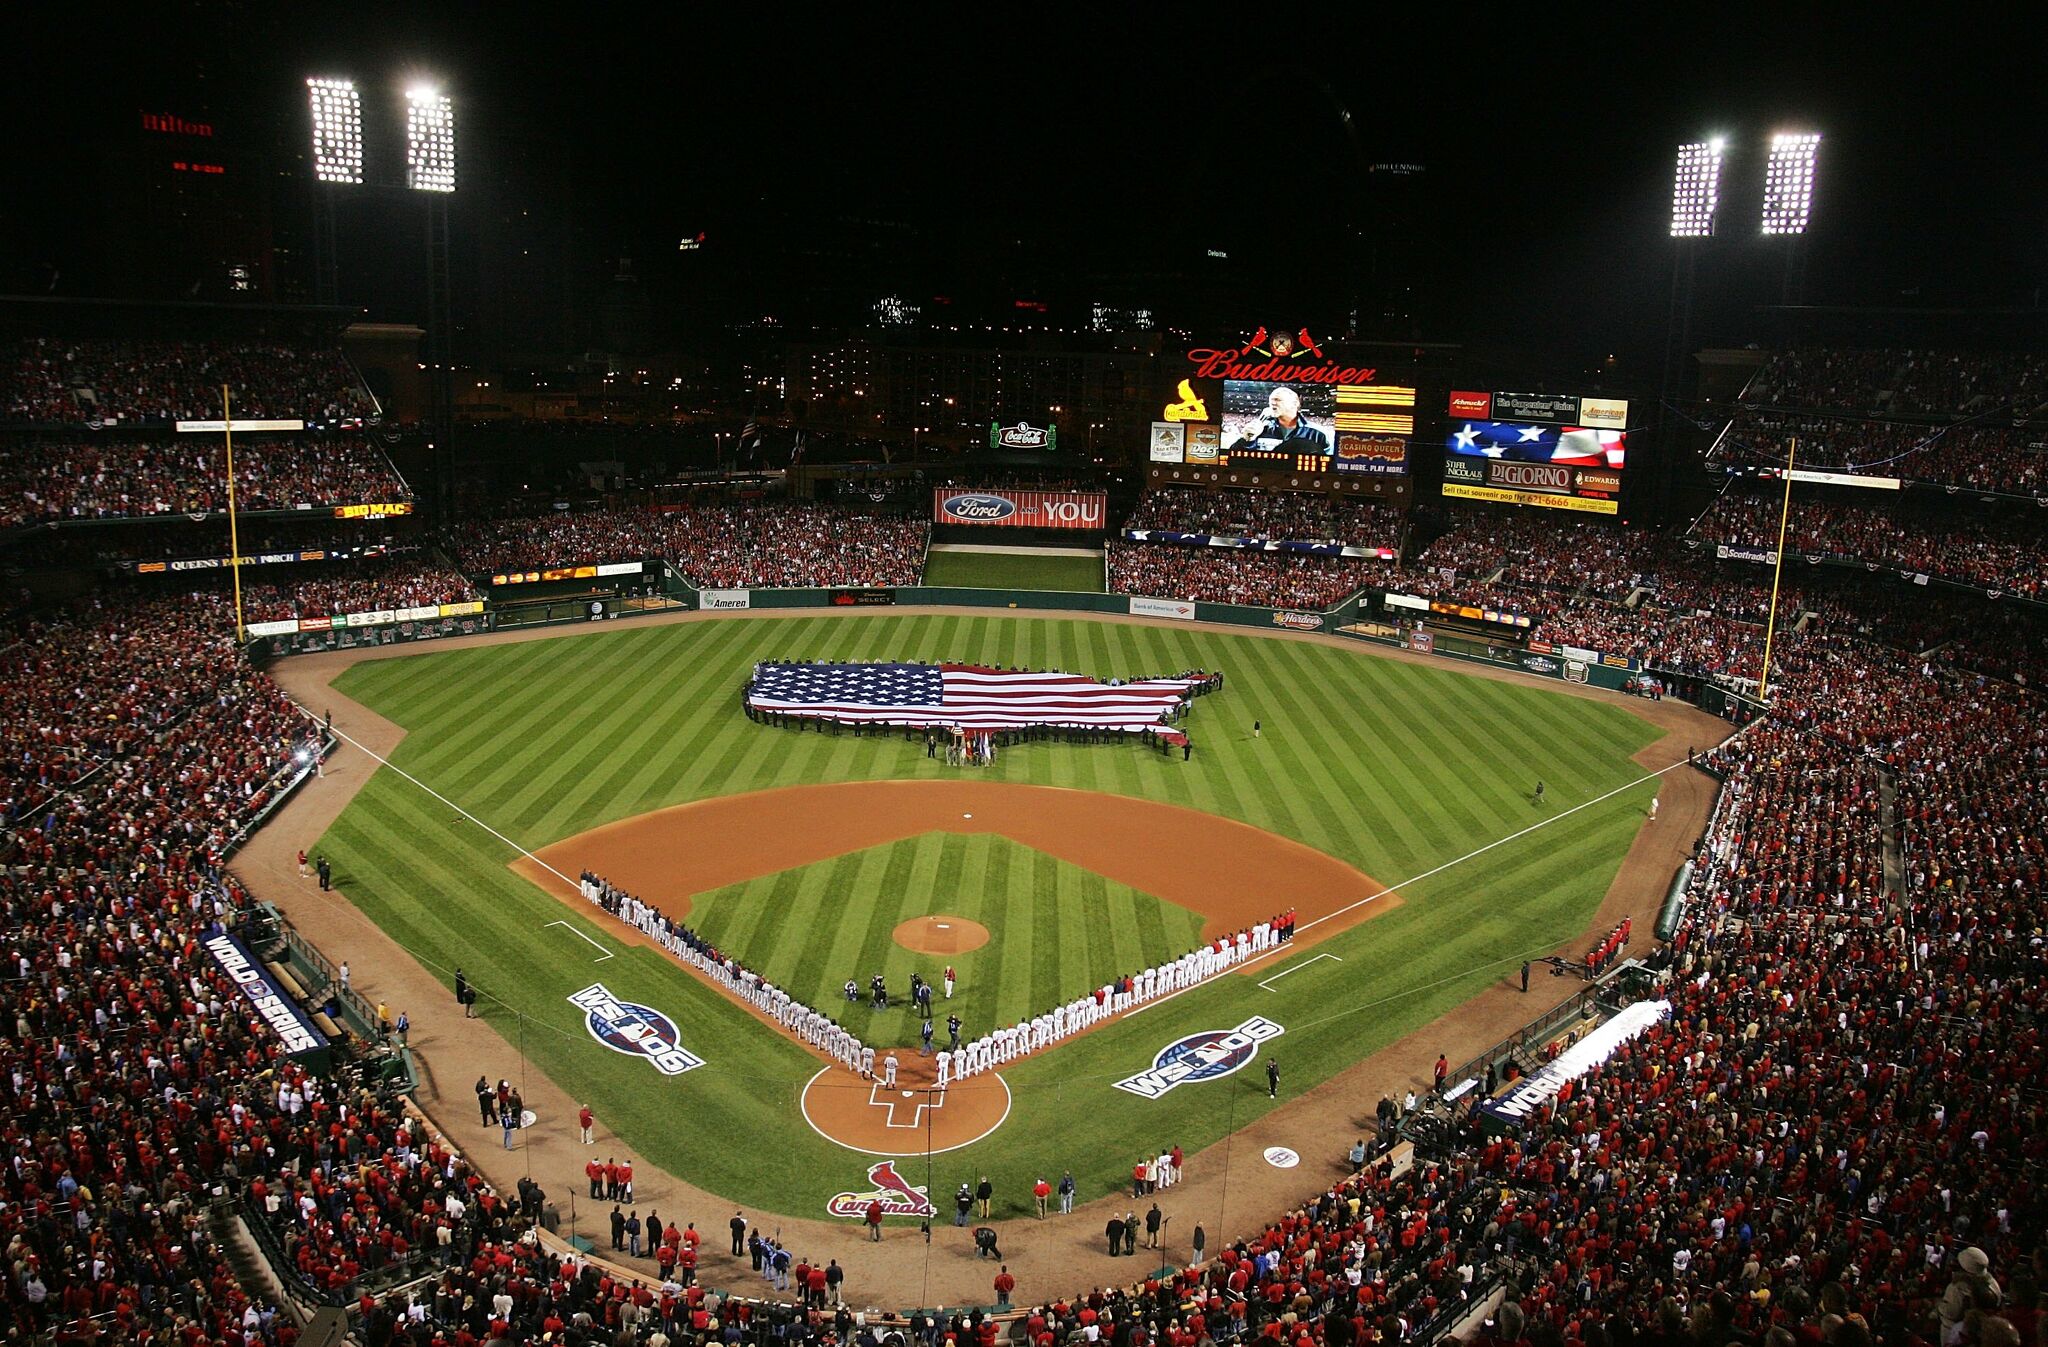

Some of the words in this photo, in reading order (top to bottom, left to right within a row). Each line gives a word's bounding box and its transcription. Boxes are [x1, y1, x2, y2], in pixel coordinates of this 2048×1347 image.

[143, 113, 212, 136] Hilton
[1188, 349, 1376, 384] Budweiser
[1452, 398, 1487, 406] Schnucks
[1497, 398, 1510, 407] The
[1589, 407, 1625, 417] American
[1344, 443, 1372, 451] CASINO
[1374, 445, 1400, 453] QUEEN
[1446, 460, 1466, 470] STIFEL
[1448, 468, 1482, 478] NICOLAUS
[1584, 475, 1619, 485] EDWARDS
[1456, 487, 1470, 496] that
[1471, 489, 1499, 498] souvenir
[1527, 495, 1569, 507] 621-6666
[343, 504, 369, 518] BIG
[370, 503, 405, 515] MAC
[956, 498, 1002, 517] Ford
[1043, 502, 1099, 521] YOU
[260, 554, 293, 563] PORCH
[714, 599, 746, 608] Ameren
[1414, 643, 1428, 651] YOU
[206, 936, 259, 983] WORLD
[254, 994, 318, 1052] SERIES
[571, 984, 629, 1021] WS
[638, 1036, 701, 1073] 06
[1119, 1061, 1195, 1096] WS
[1218, 1018, 1280, 1051] 06
